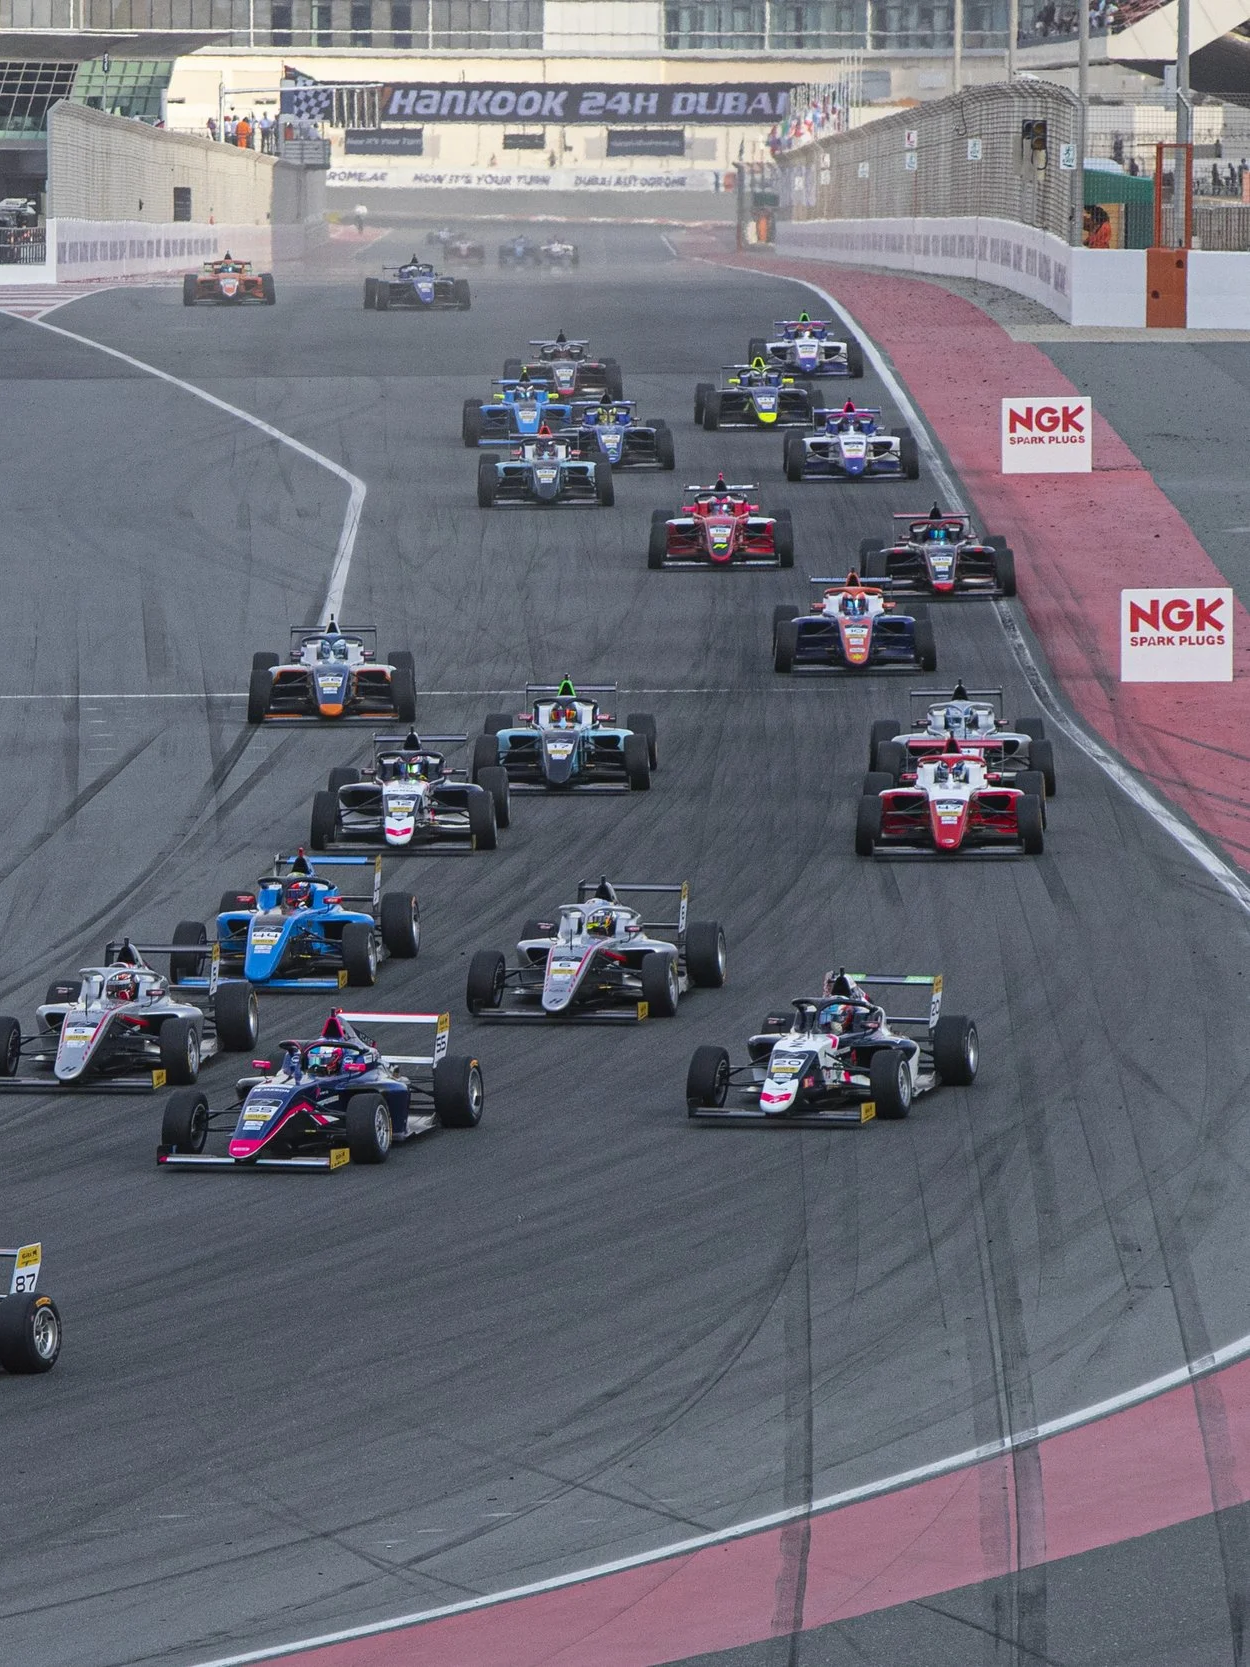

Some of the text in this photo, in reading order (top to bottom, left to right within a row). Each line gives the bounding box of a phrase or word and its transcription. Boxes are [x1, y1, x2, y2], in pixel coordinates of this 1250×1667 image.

[579, 91, 659, 116] 24H
[671, 91, 790, 116] DUBAI
[328, 171, 388, 182] ROME.AE
[1009, 405, 1085, 433] NGK
[1009, 435, 1086, 445] SPARK PLUGS
[1130, 597, 1225, 632] NGK
[1130, 635, 1225, 647] SPARK PLUGS
[15, 1273, 36, 1293] 87
